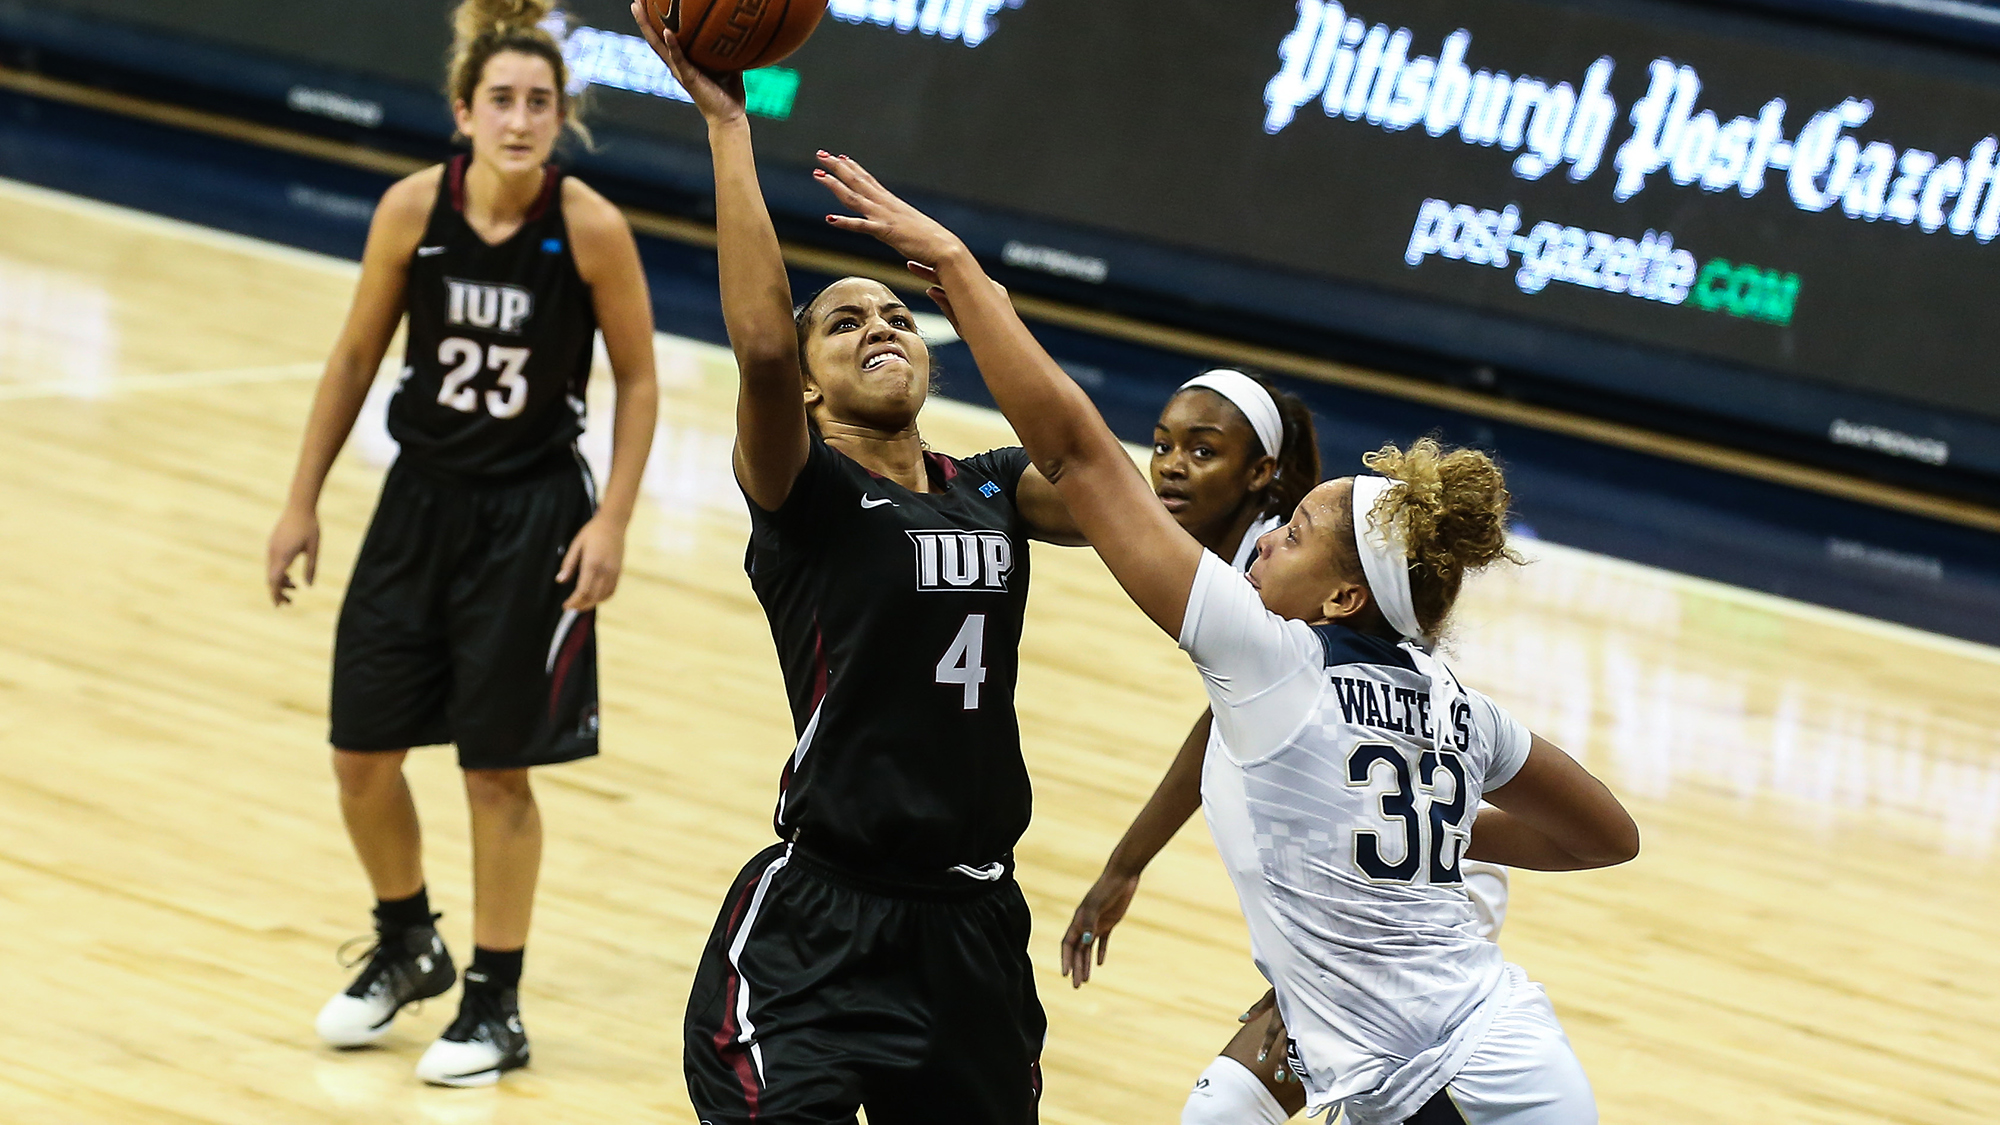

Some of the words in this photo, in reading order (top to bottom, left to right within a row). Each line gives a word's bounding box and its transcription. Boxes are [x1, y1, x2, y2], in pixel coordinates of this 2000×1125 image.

[1263, 0, 1617, 182] Pittsburgh
[445, 278, 534, 335] IUP
[437, 337, 532, 420] 23
[906, 530, 1014, 591] IUP
[935, 613, 987, 710] 4
[1331, 676, 1471, 752] WALTES
[1346, 741, 1469, 887] 32
